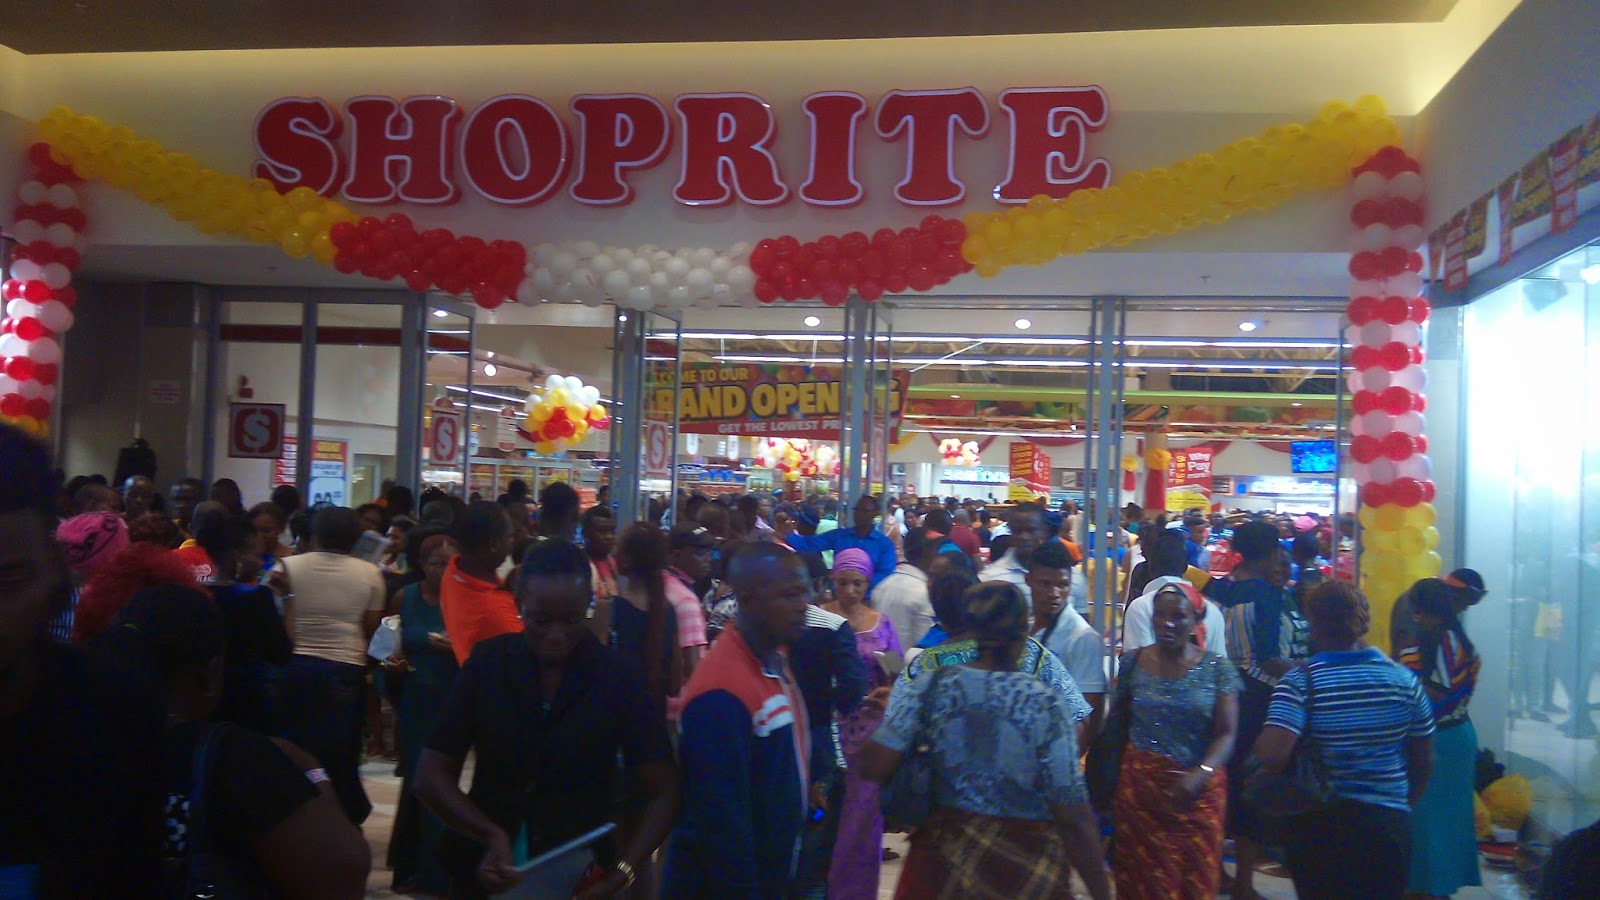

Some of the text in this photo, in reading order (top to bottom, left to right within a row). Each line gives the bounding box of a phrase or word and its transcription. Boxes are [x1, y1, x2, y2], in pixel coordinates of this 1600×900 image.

[255, 85, 1110, 205] SHOPRITE
[701, 369, 717, 383] TO
[720, 367, 749, 381] OUR
[718, 423, 740, 433] GET
[744, 422, 767, 432] THE
[771, 420, 818, 431] LOWEST
[1187, 461, 1211, 475] Pay
